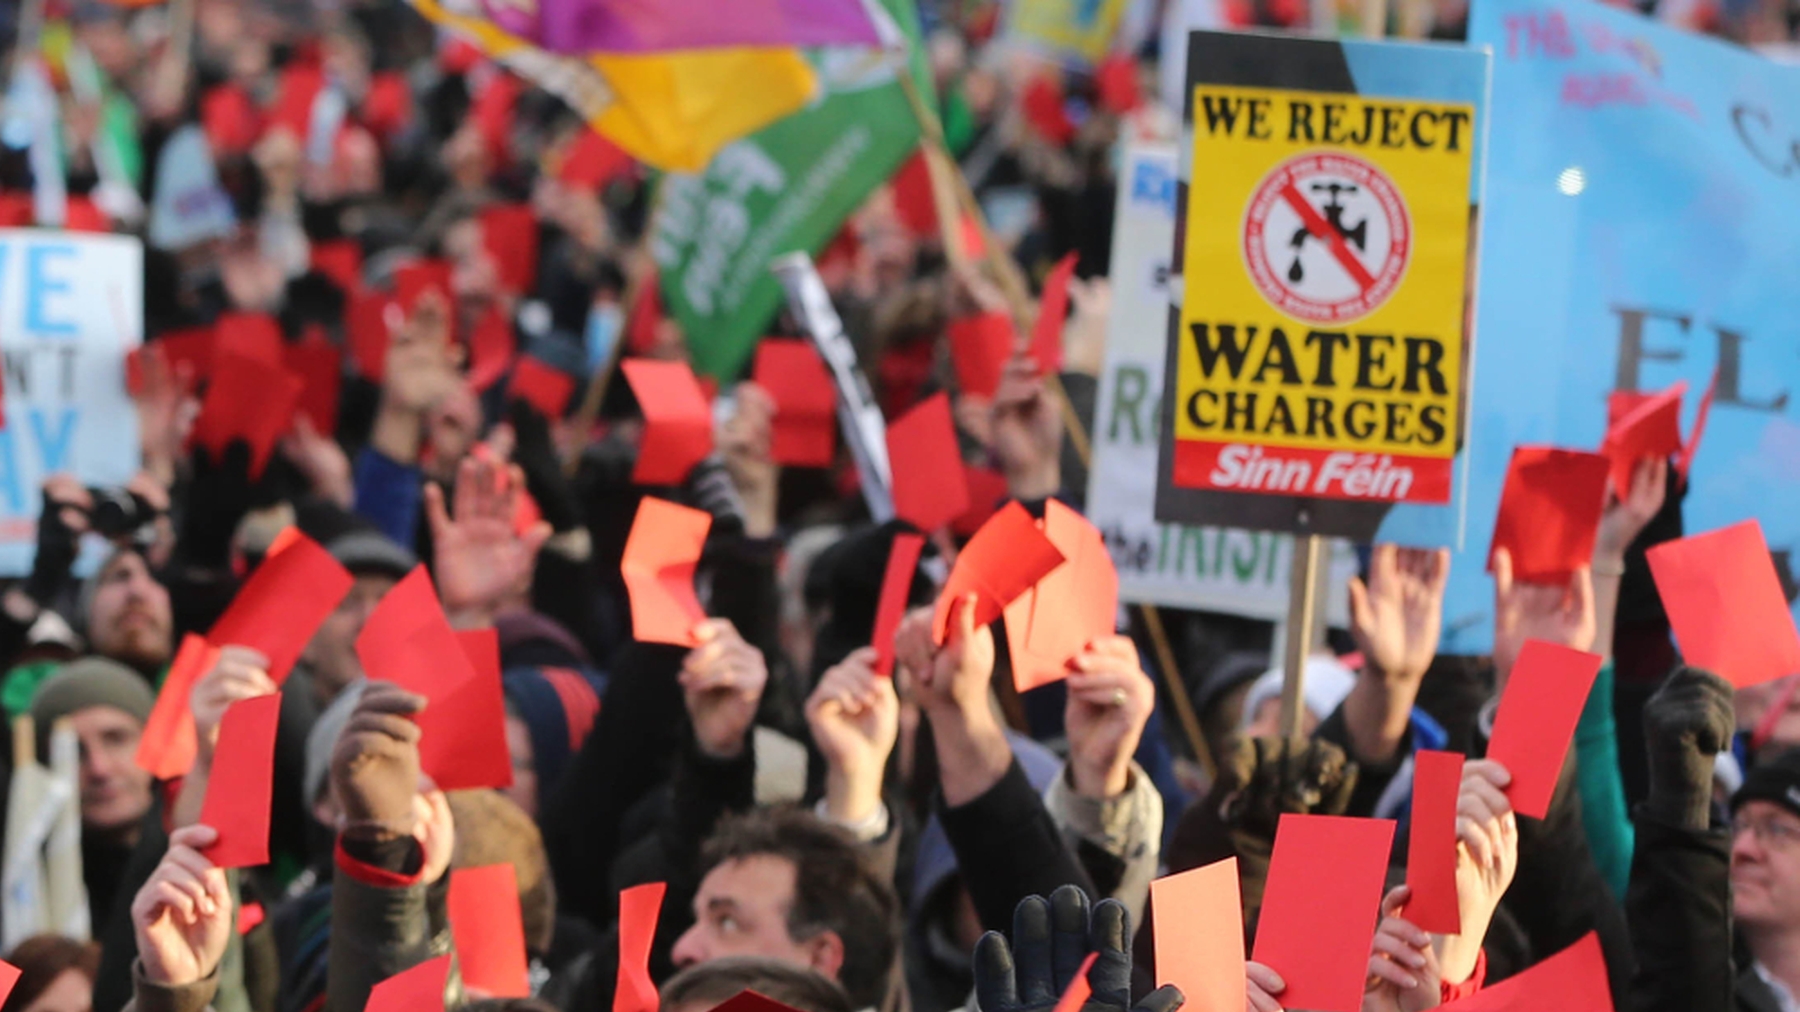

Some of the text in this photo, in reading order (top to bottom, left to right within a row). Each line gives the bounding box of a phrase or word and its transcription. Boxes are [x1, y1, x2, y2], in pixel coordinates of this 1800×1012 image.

[1202, 95, 1469, 150] WE REJECT
[1190, 322, 1448, 396] WATER
[1186, 390, 1447, 445] CHARGES
[1211, 445, 1413, 498] Sinn Féin
